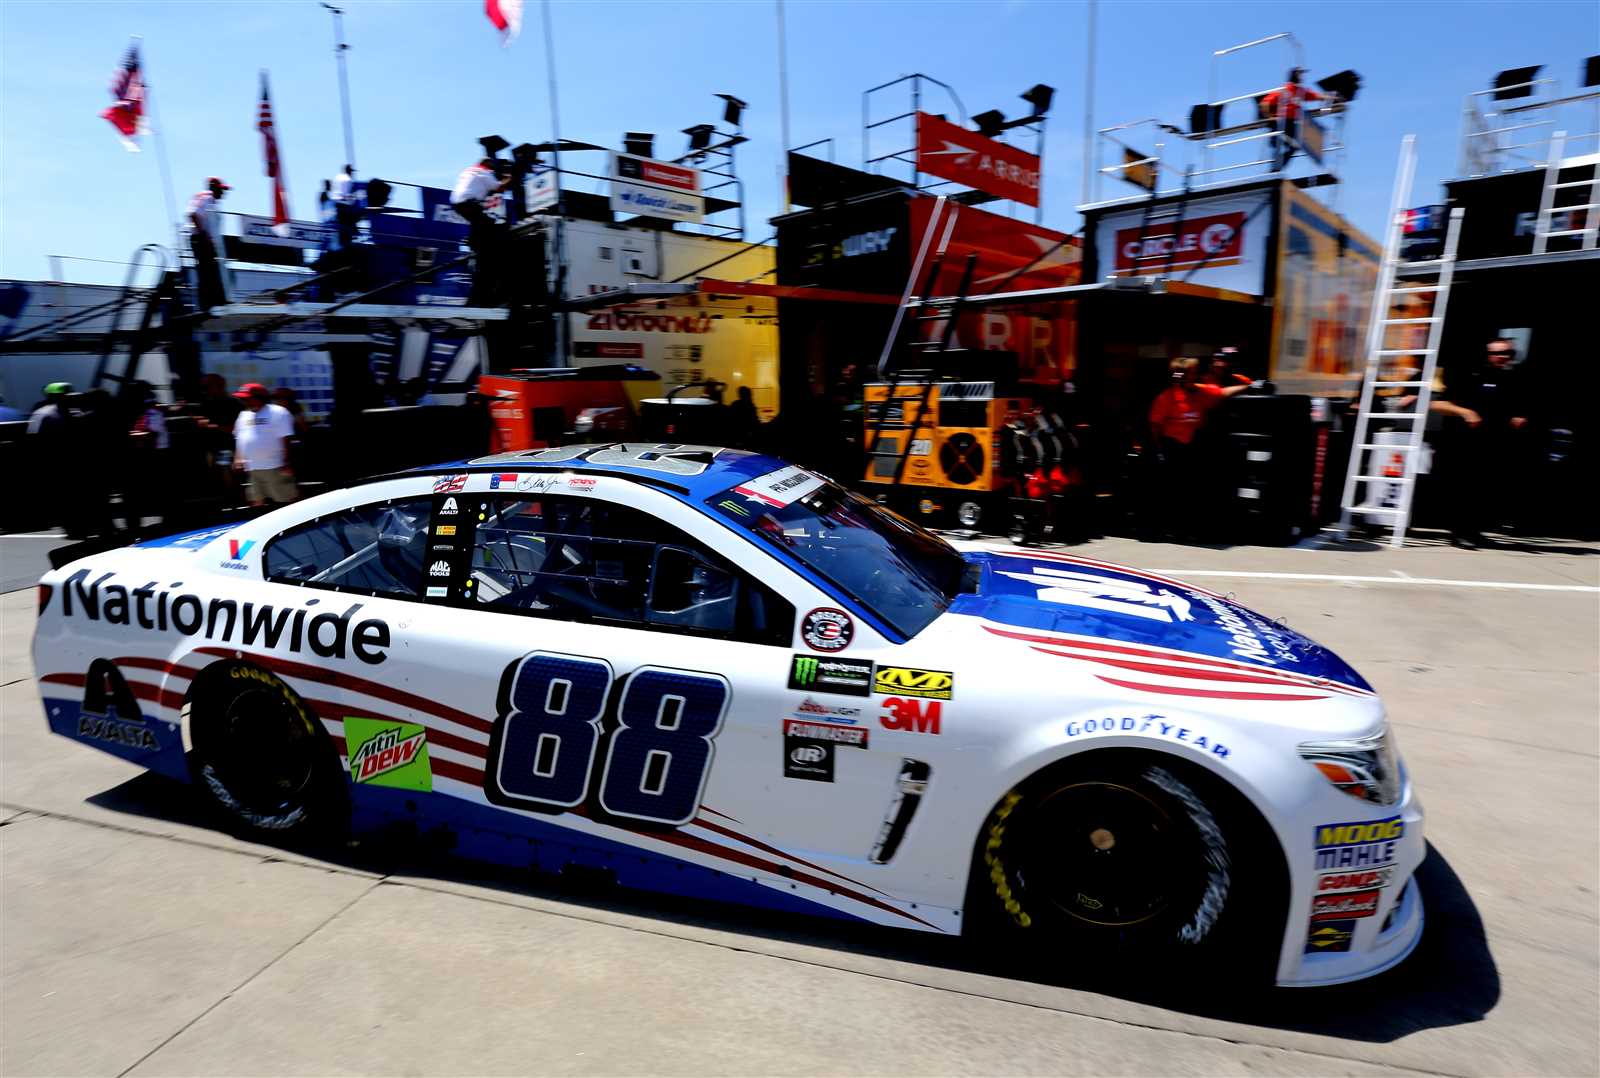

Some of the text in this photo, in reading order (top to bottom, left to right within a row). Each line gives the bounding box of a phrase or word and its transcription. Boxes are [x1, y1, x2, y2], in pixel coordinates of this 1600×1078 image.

[62, 569, 391, 665] Nationwide
[79, 715, 161, 752] AXALTA
[879, 697, 943, 735] 3M
[484, 649, 733, 833] 88
[1066, 715, 1232, 759] GOODYEAR
[1320, 818, 1403, 846] MOOG
[1314, 842, 1394, 871] MAHLE
